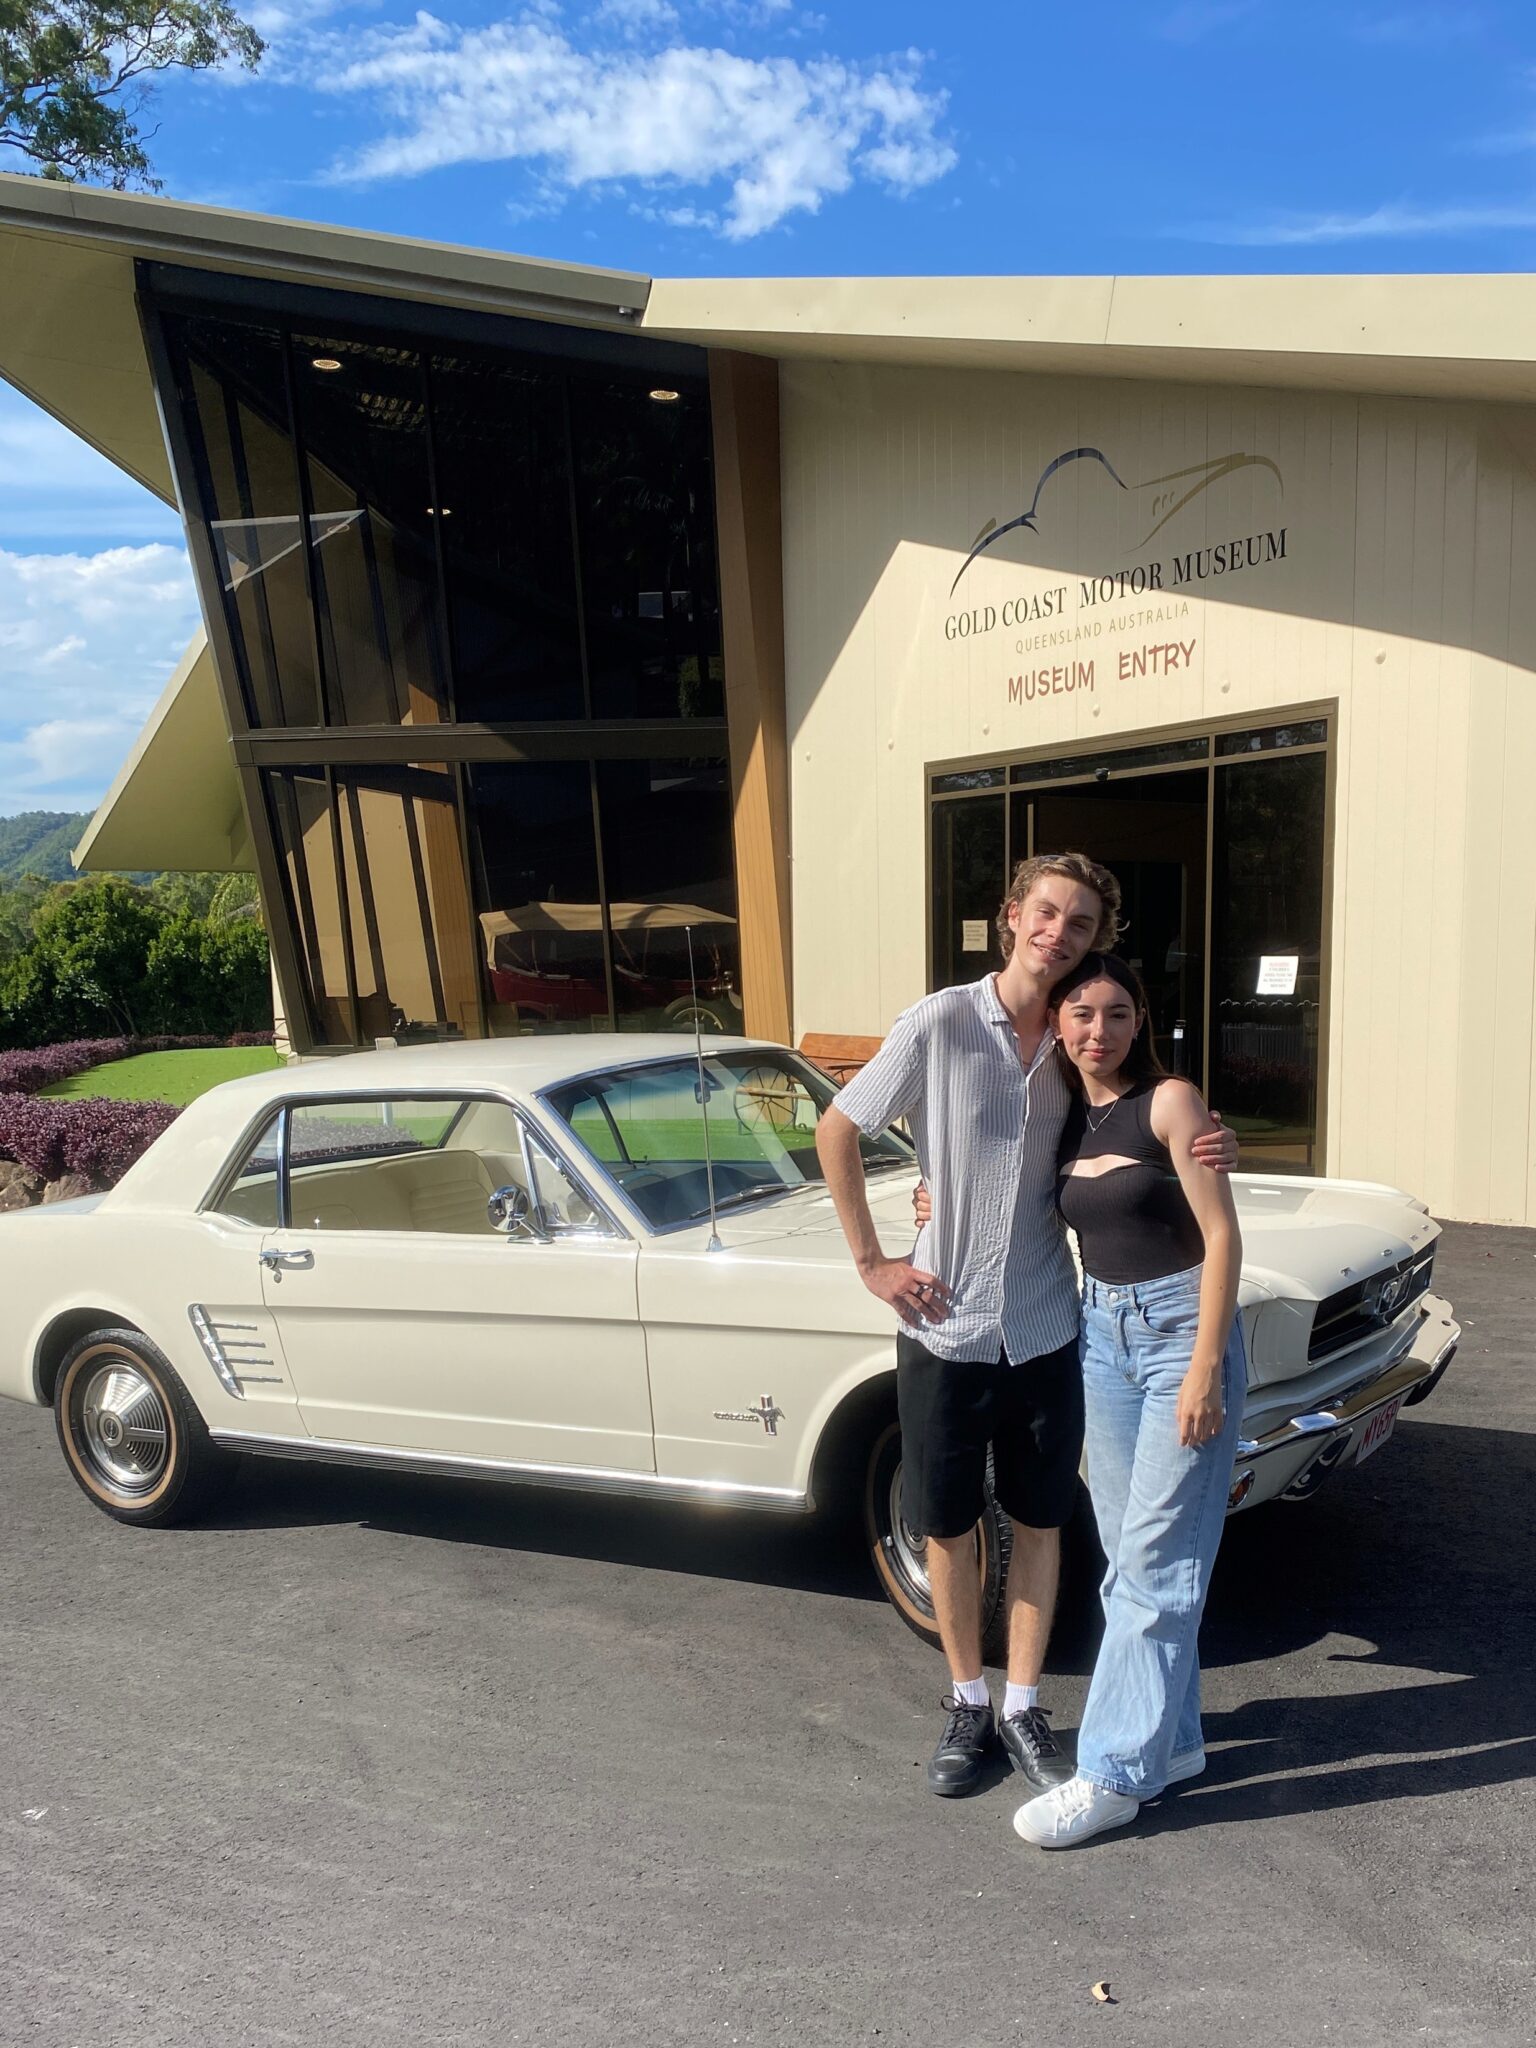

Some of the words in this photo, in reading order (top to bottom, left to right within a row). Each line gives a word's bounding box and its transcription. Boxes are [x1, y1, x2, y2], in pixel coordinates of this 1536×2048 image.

[944, 606, 997, 641] GOLD
[1001, 586, 1068, 627] COAST
[1079, 561, 1163, 609] MOTOR
[1171, 527, 1288, 586] MUSEUM
[1015, 621, 1102, 655] QUEENSLAND
[1108, 600, 1190, 633] AUSTRALIA
[1008, 659, 1095, 706] MUSEUM
[1118, 638, 1196, 681] ENTRY
